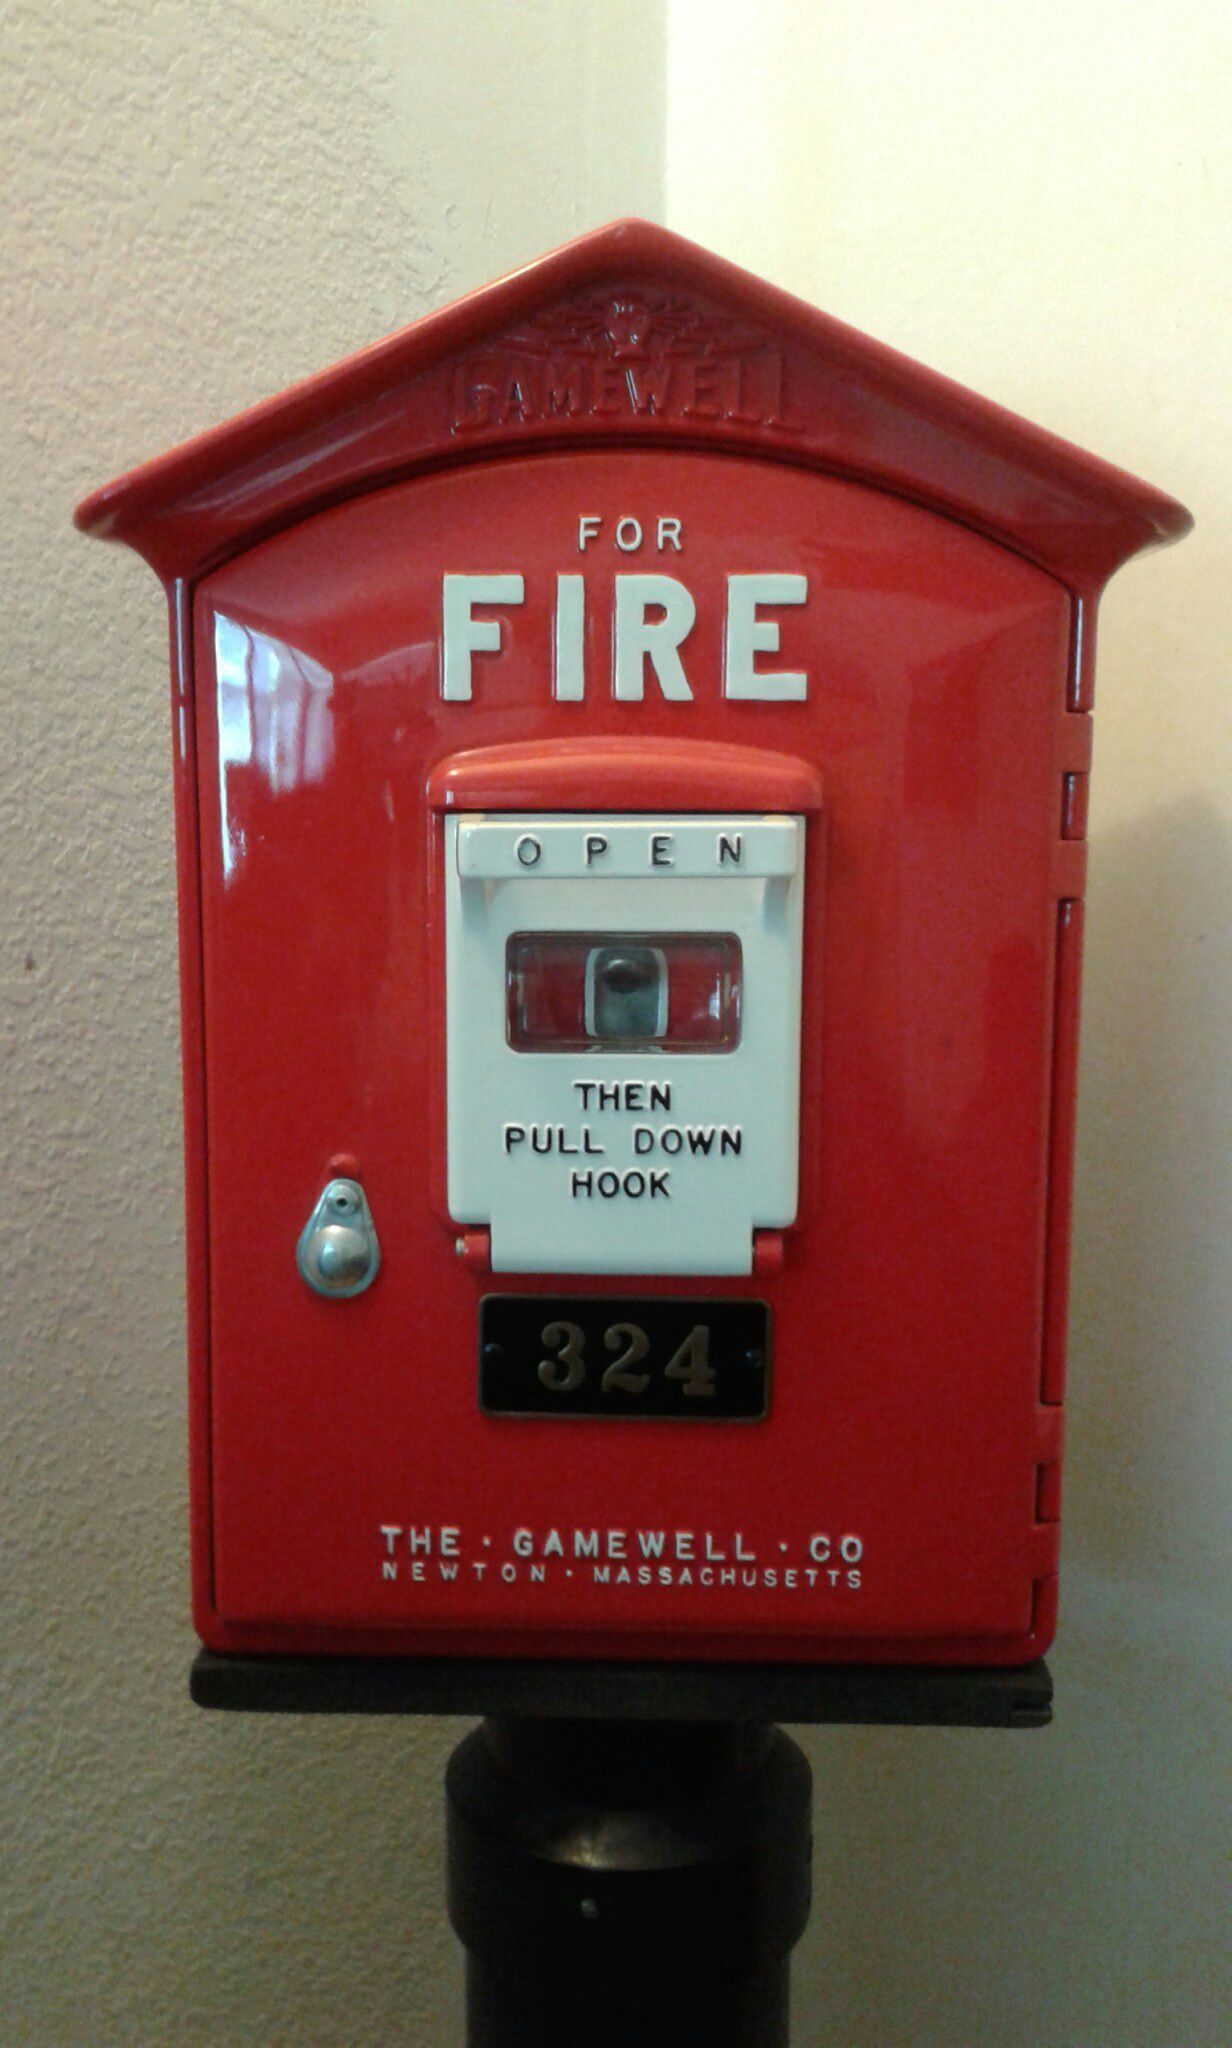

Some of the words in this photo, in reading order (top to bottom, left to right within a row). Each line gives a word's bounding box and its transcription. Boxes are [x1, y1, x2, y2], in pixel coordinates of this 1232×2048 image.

[578, 516, 683, 551] FOR
[441, 573, 809, 701] FIRE
[516, 834, 743, 866] OPEN
[574, 1082, 671, 1111] THEN
[505, 1127, 604, 1155] PULL
[634, 1129, 742, 1155] DOWN
[572, 1171, 671, 1199] HOOK
[537, 1320, 717, 1396] 324
[380, 1526, 460, 1557] THE
[513, 1528, 756, 1561] GAMEWELL
[810, 1536, 864, 1563] CO
[381, 1562, 546, 1582] NEWTON
[594, 1566, 862, 1589] MASSACHUSETTS
